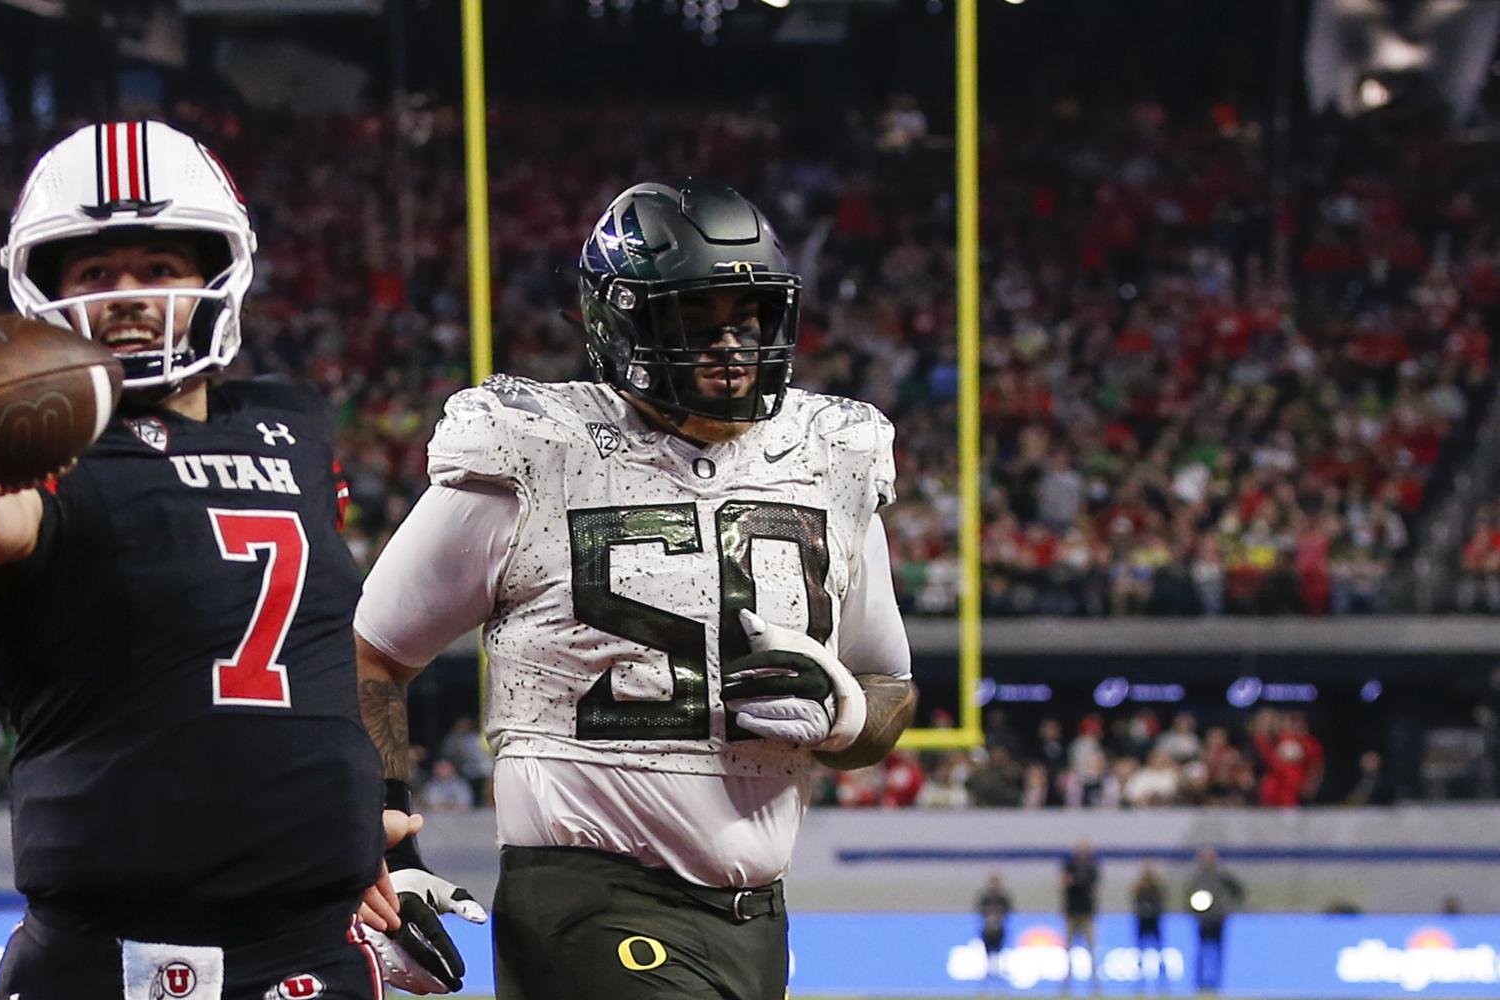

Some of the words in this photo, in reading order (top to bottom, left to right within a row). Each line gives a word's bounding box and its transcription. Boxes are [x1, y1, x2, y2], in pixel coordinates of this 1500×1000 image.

[169, 454, 301, 495] UTAH
[207, 507, 310, 709] 7
[567, 498, 836, 742] 50
